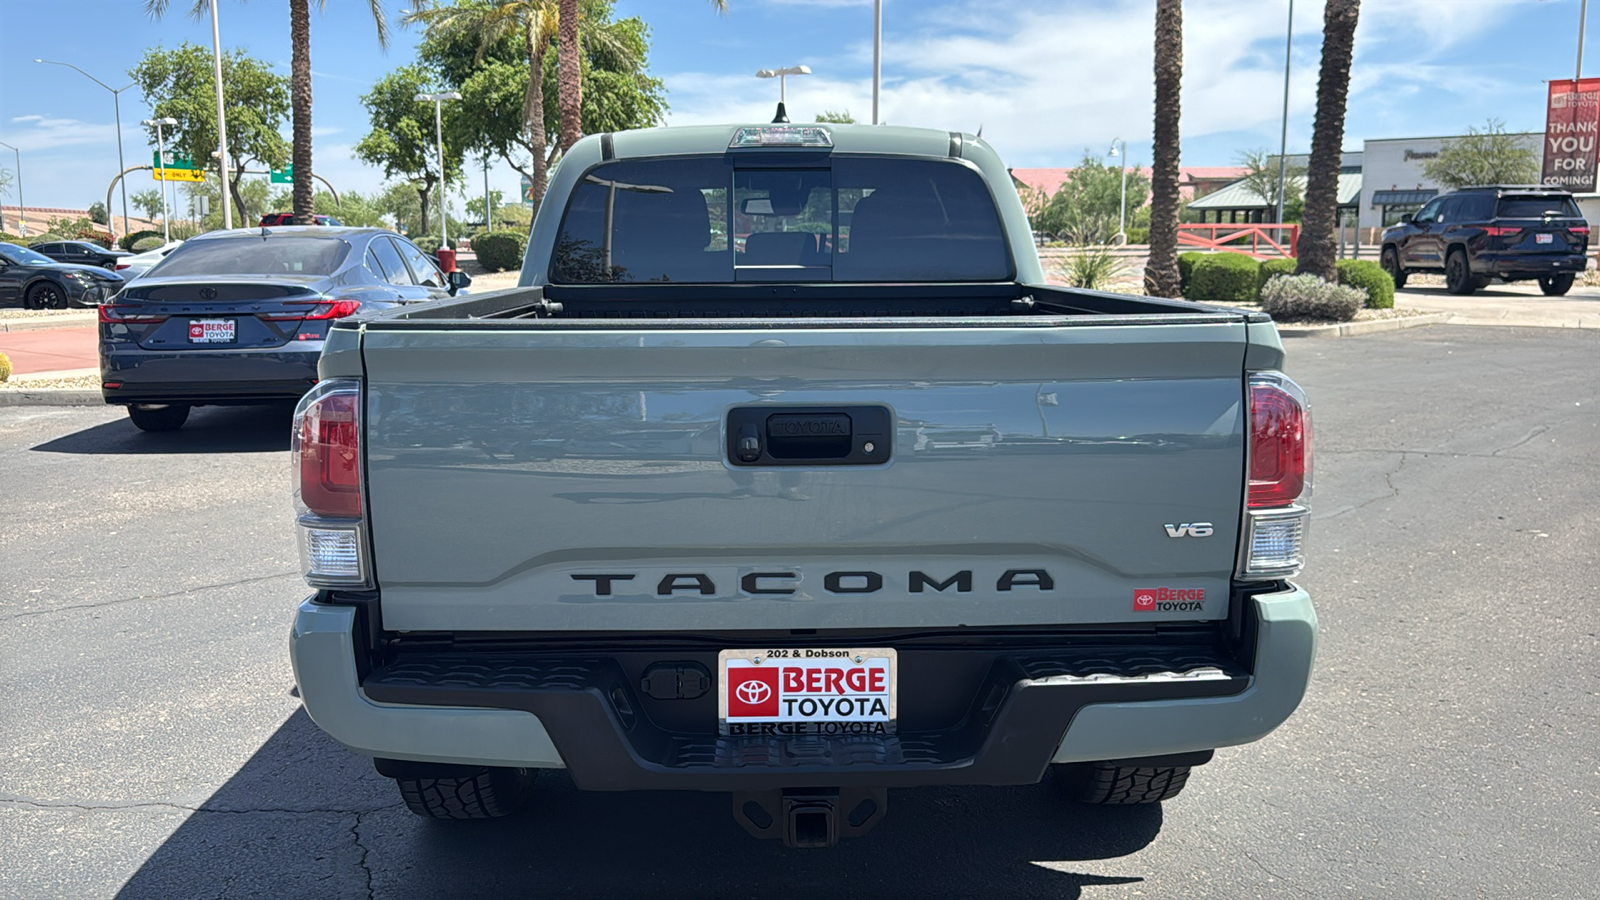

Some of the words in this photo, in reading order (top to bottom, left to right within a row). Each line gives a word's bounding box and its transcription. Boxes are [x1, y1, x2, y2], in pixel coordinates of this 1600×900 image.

[1567, 91, 1598, 101] BERGE
[1567, 100, 1598, 108] TOYOTA
[1549, 121, 1597, 134] THANK
[1548, 136, 1594, 153] YOU
[1554, 158, 1586, 171] FOR
[1543, 175, 1594, 186] COMING!
[205, 323, 234, 331] BERGE
[775, 420, 845, 434] TOYOTA
[1164, 522, 1214, 538] V6
[570, 568, 1055, 596] TACOMA
[1157, 587, 1205, 602] BERGE
[1157, 602, 1203, 611] TOYOTA
[767, 649, 788, 658] 202
[792, 650, 801, 658] &
[805, 649, 849, 658] Dobson
[782, 667, 886, 695] BERGE
[782, 698, 887, 716] TOYOTA
[729, 722, 807, 736] BERGE
[816, 722, 887, 734] TOYOTA
